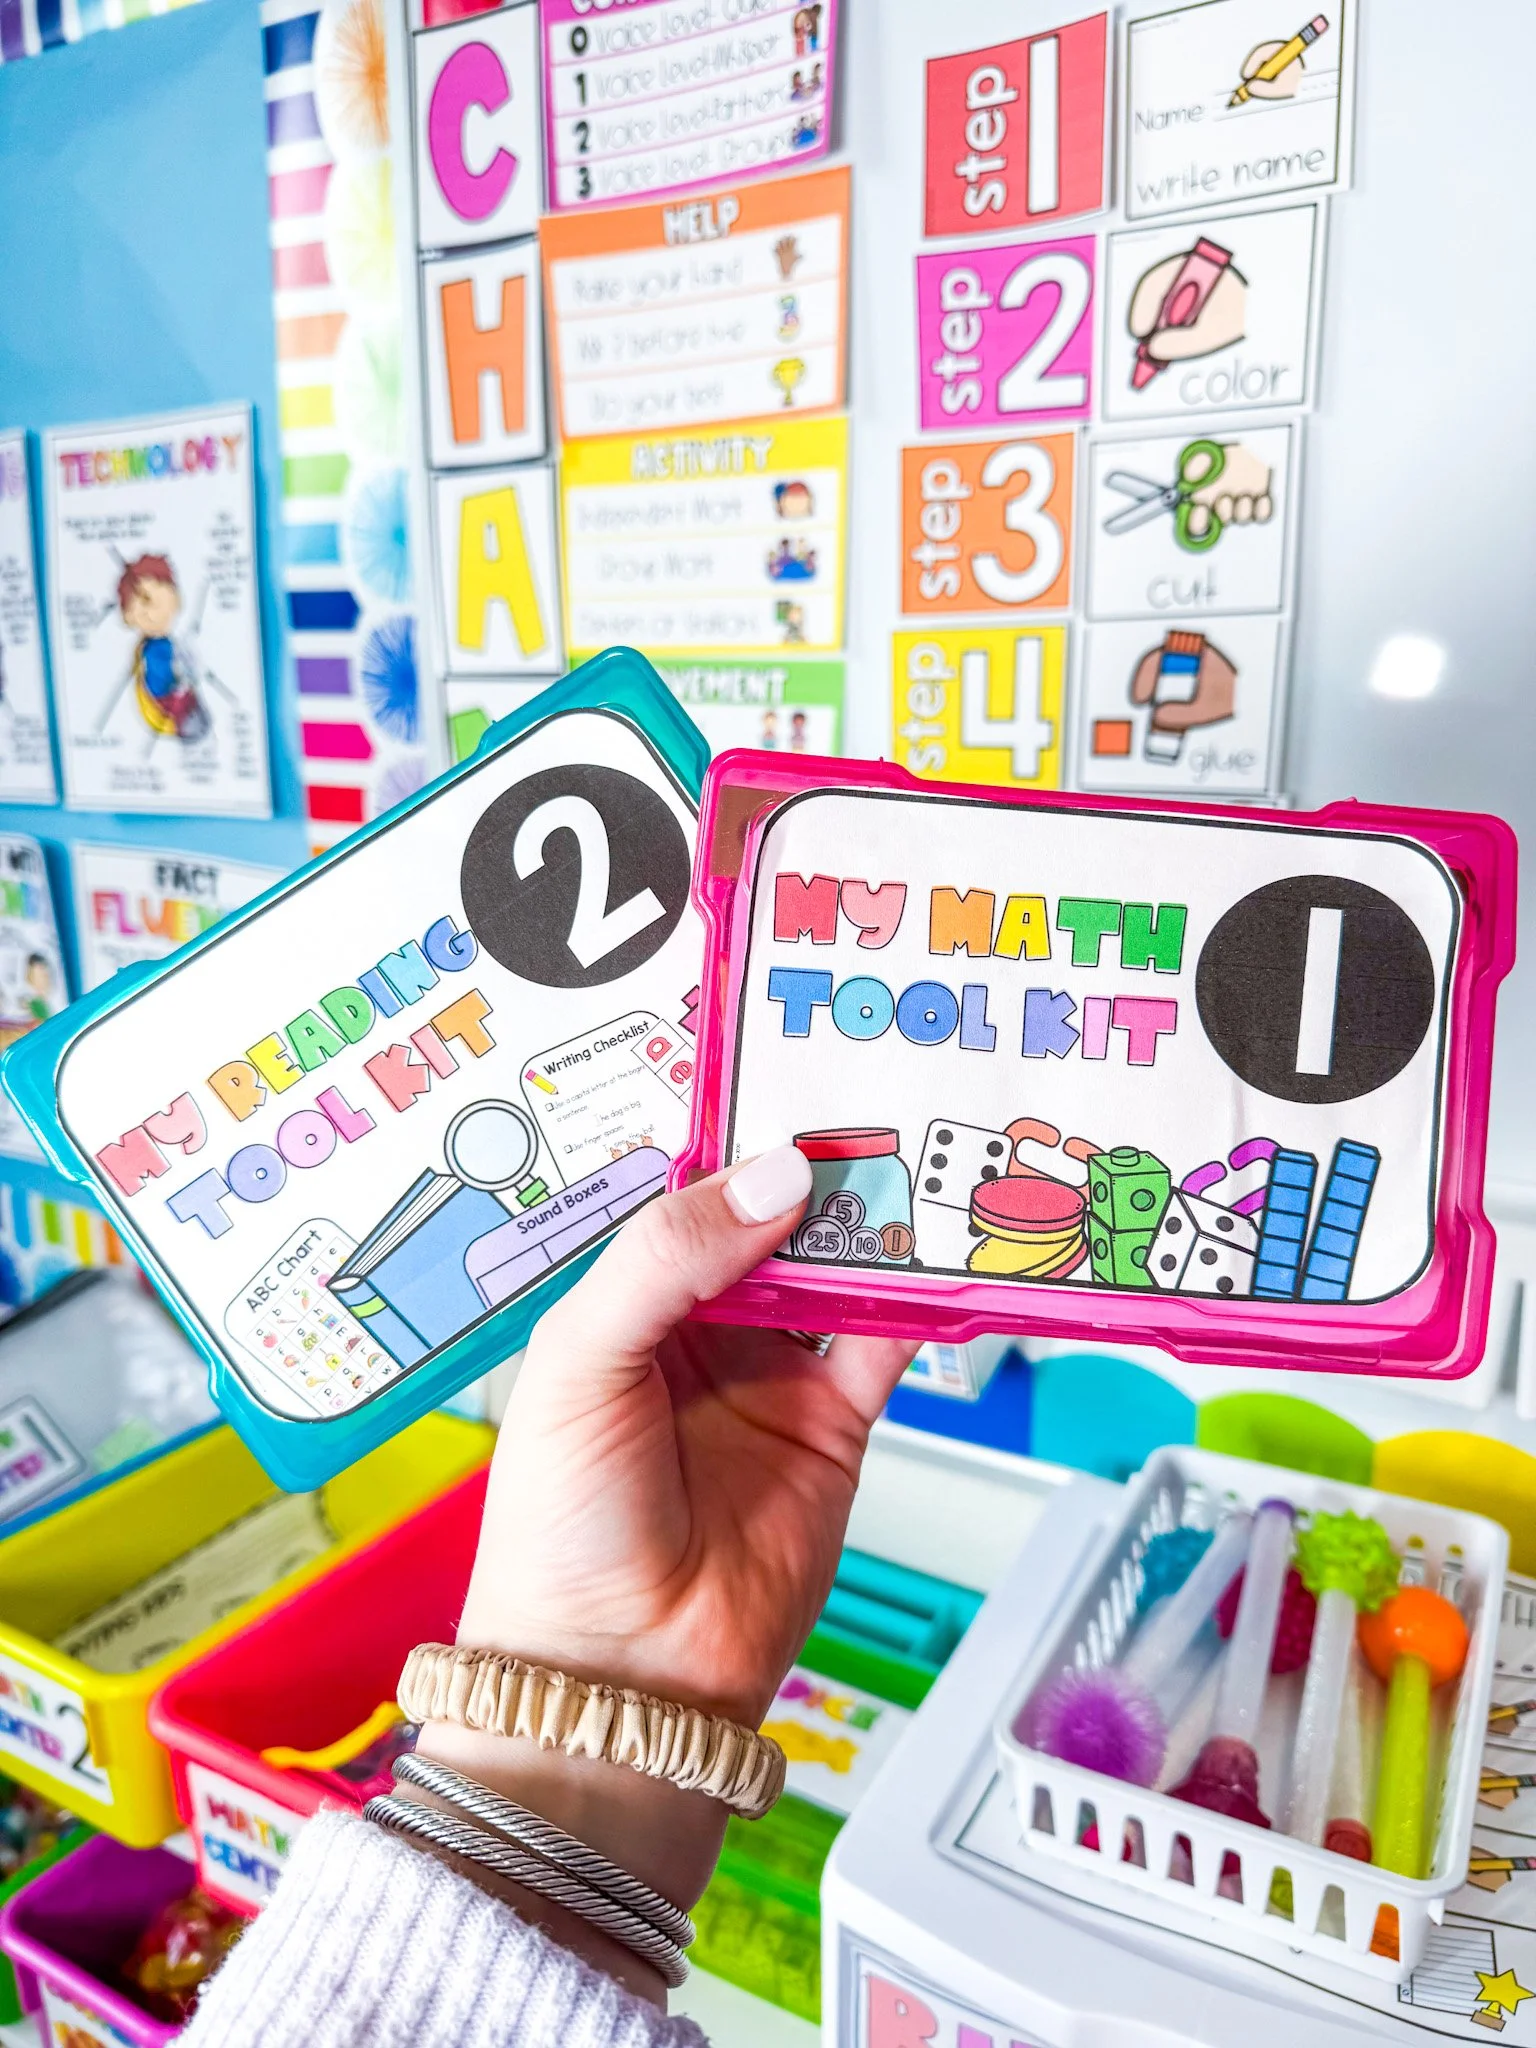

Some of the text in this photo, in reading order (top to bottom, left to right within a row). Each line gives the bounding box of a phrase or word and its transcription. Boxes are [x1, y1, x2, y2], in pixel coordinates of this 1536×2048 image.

[429, 41, 518, 221] C
[954, 33, 1060, 218] step 1
[1135, 102, 1203, 134] Name
[1137, 145, 1326, 206] write name
[663, 196, 741, 246] HELP
[440, 274, 527, 444] H
[931, 250, 1094, 415] step 2
[1179, 357, 1290, 406] color
[59, 433, 243, 488] TECHNOLOGY
[630, 435, 773, 481] ACTIVITY
[910, 441, 1065, 604] step 3
[457, 486, 546, 656] A
[1146, 565, 1219, 610] cut
[900, 635, 1054, 780] step 4
[1188, 744, 1258, 785] glue
[154, 859, 220, 895] FACT
[512, 794, 668, 970] 2
[774, 872, 1188, 975] MY MATH
[768, 966, 1178, 1066] TOOL KIT
[1296, 907, 1343, 1076] 1
[95, 914, 480, 1197] MY READING
[543, 1020, 650, 1076] Writing Checklist
[646, 1036, 673, 1063] a
[670, 1060, 693, 1085] e
[165, 987, 497, 1240] TOOL KIT
[611, 1107, 624, 1120] dog
[517, 1178, 609, 1234] Sound Boxes
[836, 1200, 852, 1223] 5
[807, 1230, 840, 1253] 25
[855, 1236, 877, 1254] 10
[246, 1229, 322, 1313] ABC Chart
